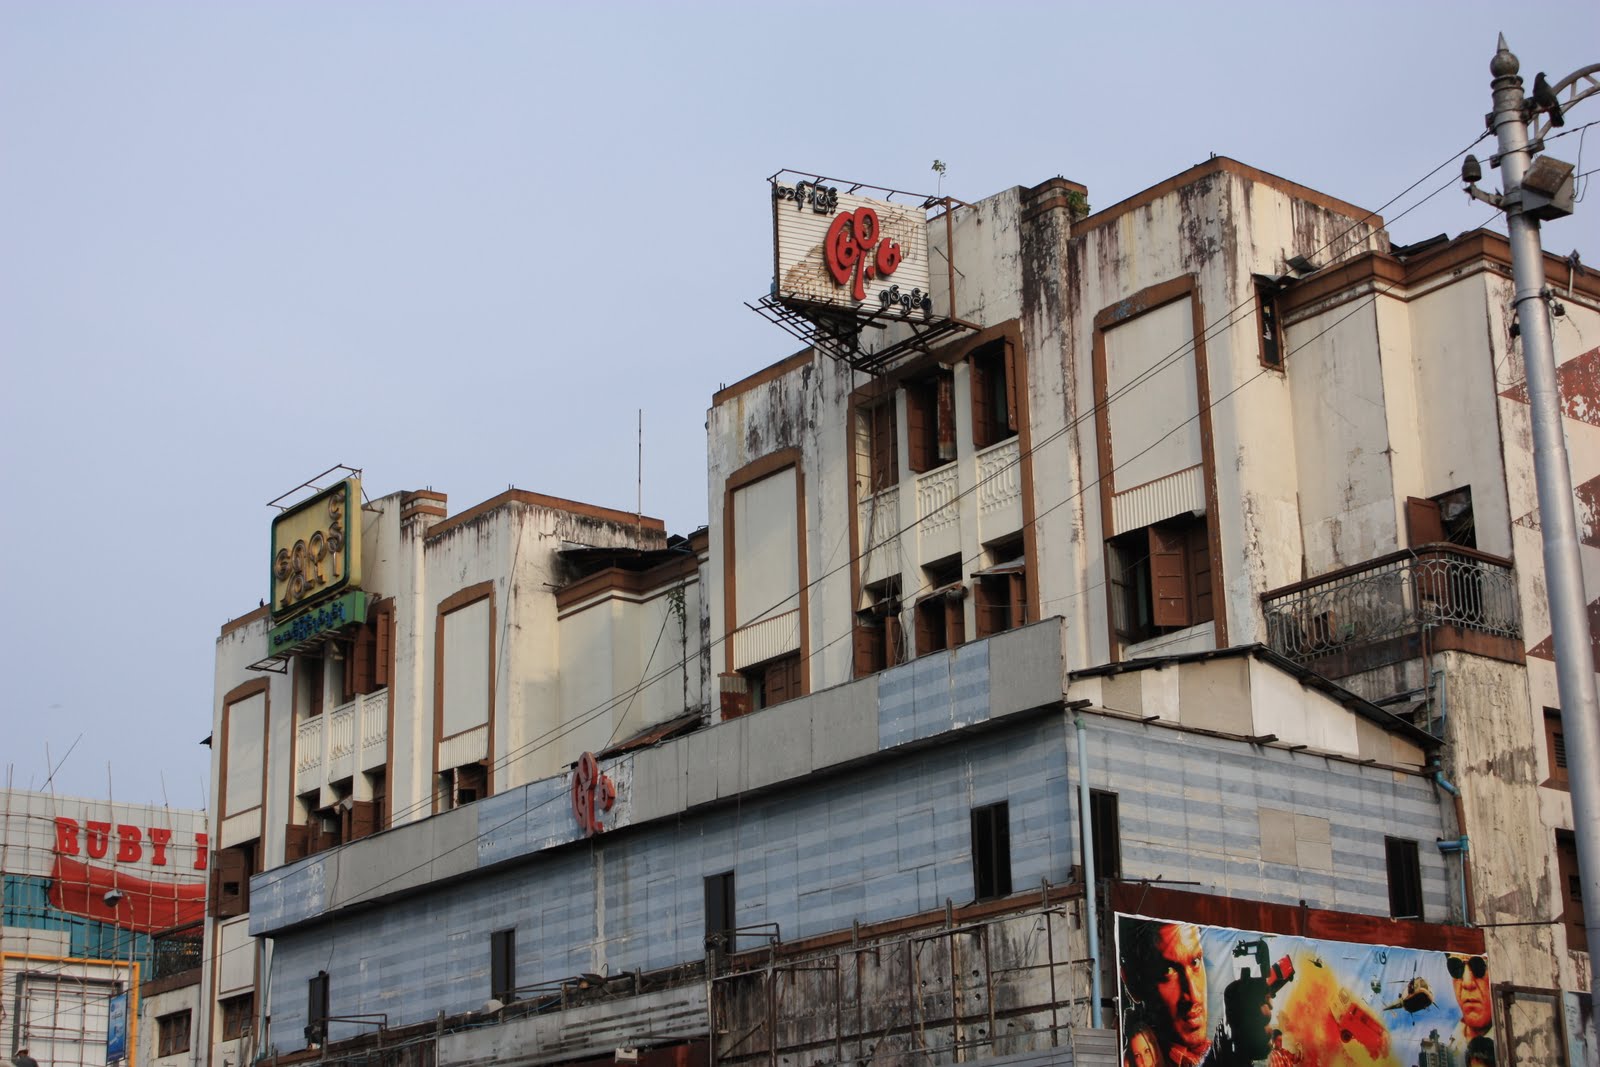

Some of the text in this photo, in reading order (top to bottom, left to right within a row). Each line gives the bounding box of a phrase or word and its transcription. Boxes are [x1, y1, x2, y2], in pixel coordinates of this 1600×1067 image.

[825, 207, 902, 301] မြို့မ
[53, 816, 171, 866] RUBY
